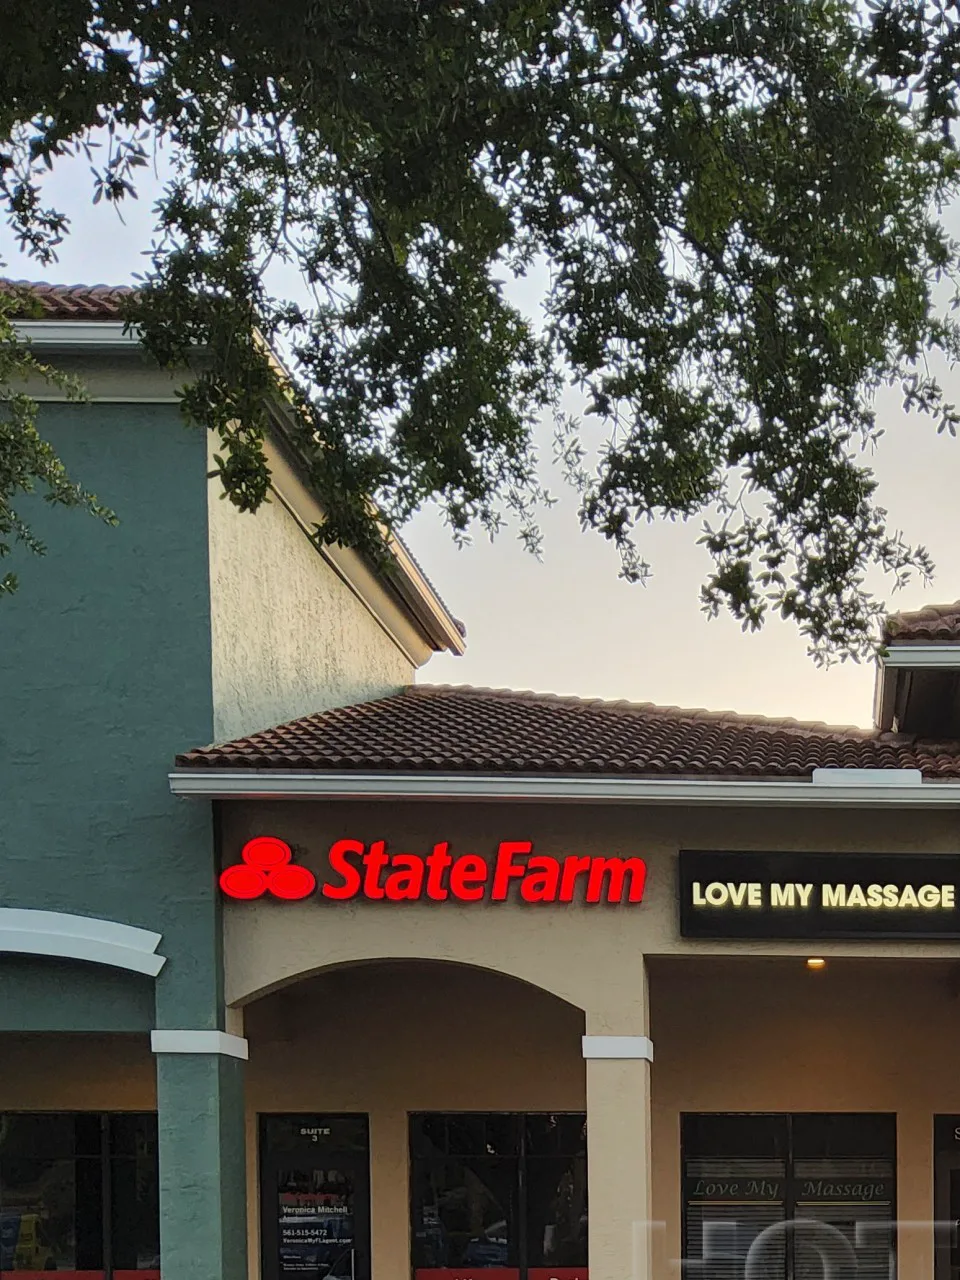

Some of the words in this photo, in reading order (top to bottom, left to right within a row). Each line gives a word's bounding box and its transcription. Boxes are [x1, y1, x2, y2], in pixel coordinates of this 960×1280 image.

[692, 882, 761, 906] LOVE
[770, 883, 813, 906] MY
[822, 884, 955, 908] MASSAGE
[300, 1127, 330, 1135] SUITE
[693, 1180, 739, 1196] Love
[745, 1180, 779, 1199] My
[801, 1182, 885, 1200] Massage
[282, 1206, 316, 1214] Veronica
